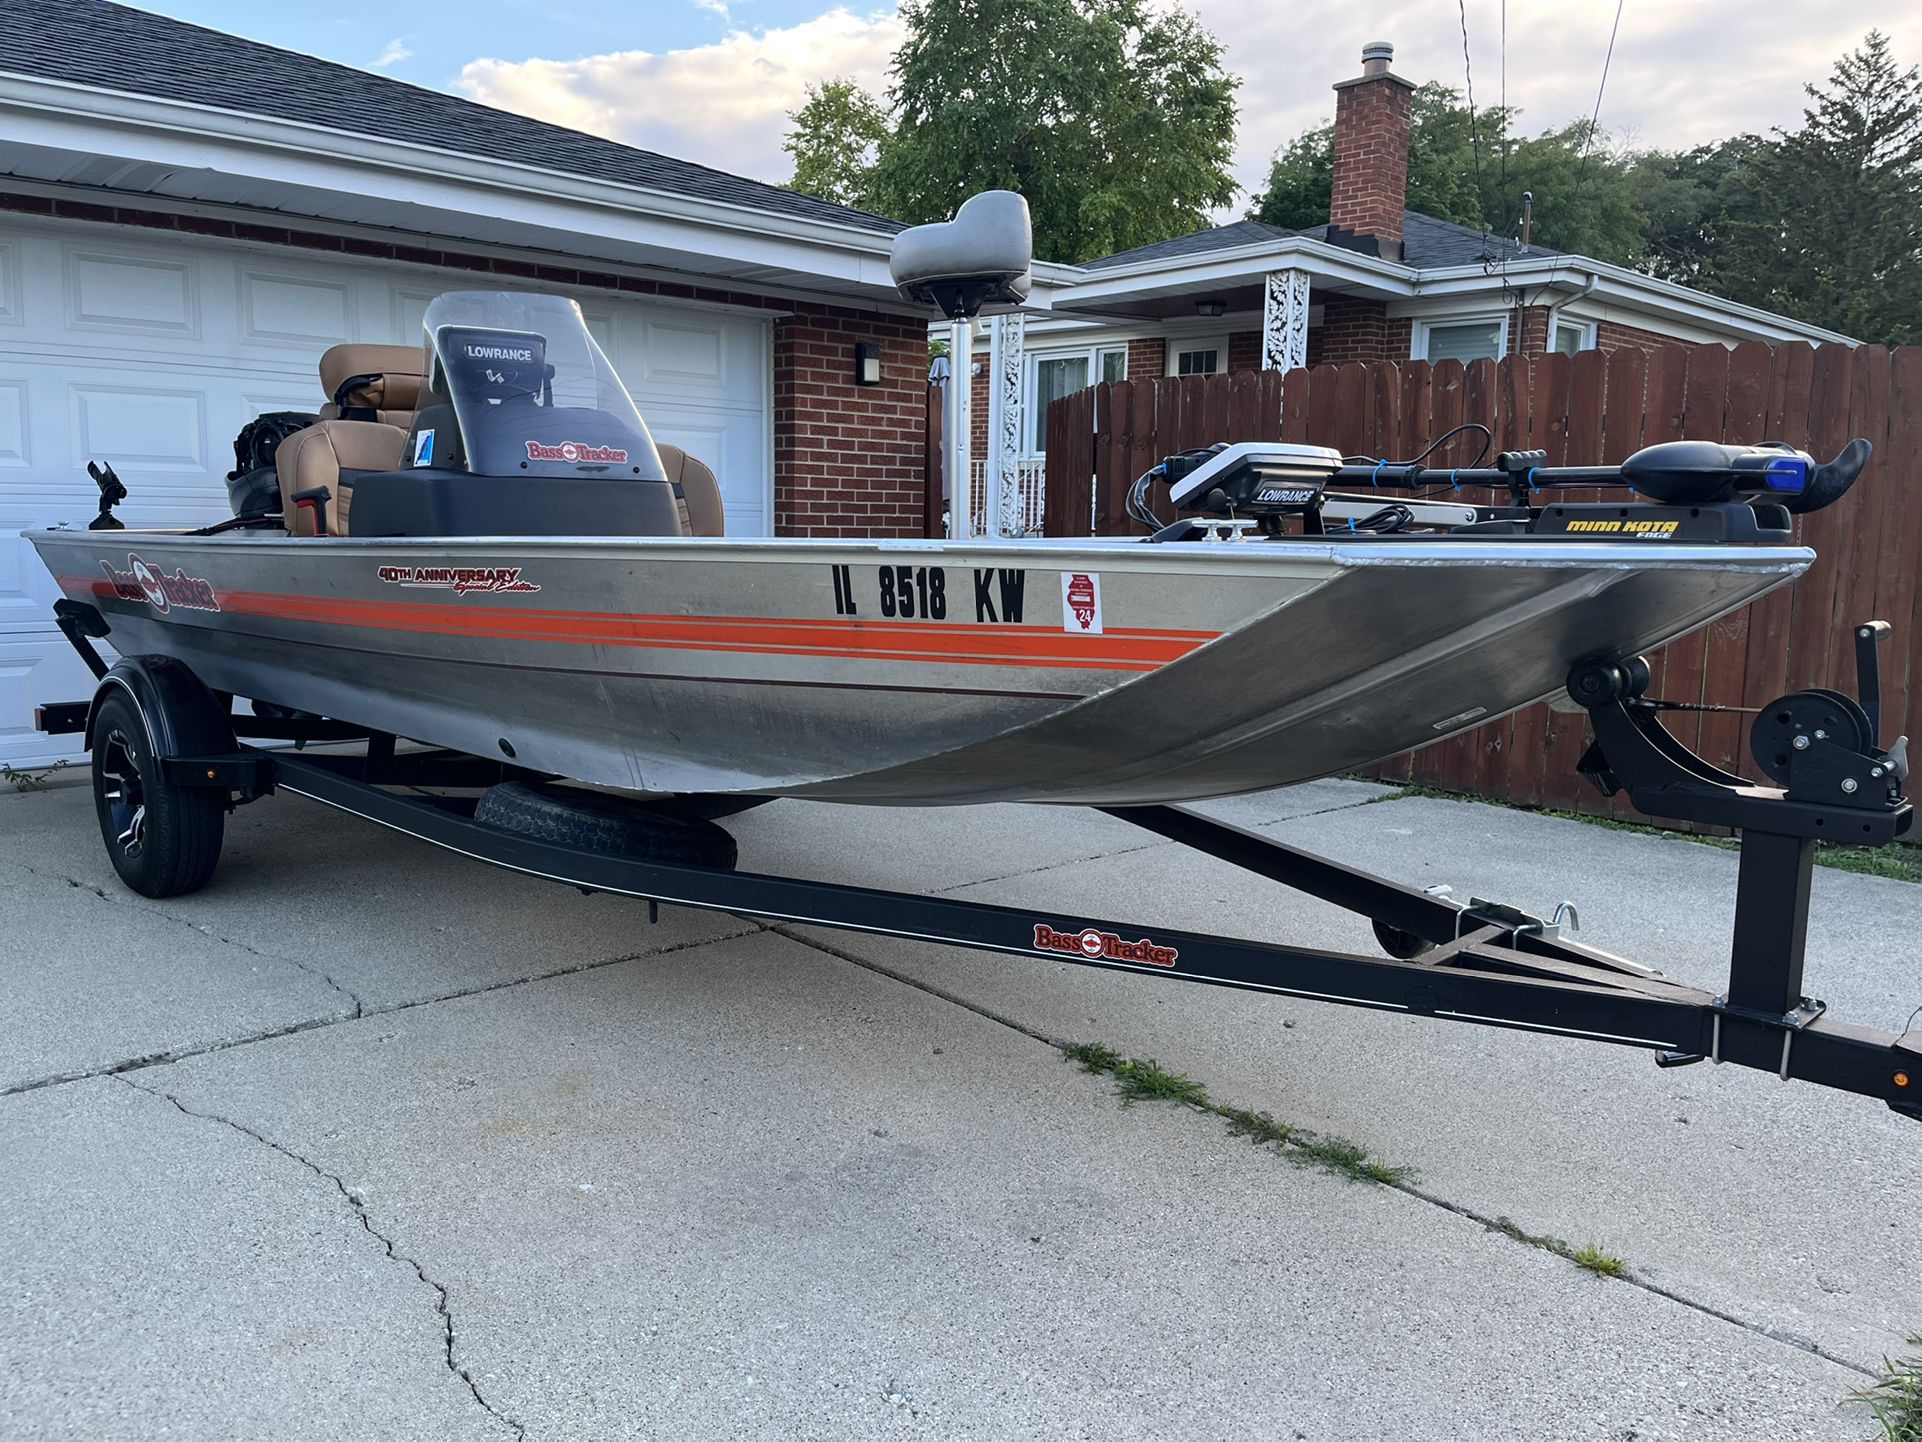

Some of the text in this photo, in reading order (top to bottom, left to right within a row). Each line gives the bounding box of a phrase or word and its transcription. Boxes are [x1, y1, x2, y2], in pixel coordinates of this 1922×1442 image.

[468, 345, 532, 361] LOWRANCE
[528, 442, 627, 463] Bass Tracker
[1257, 489, 1314, 502] LOWRANCE
[1622, 521, 1679, 532] KOTA
[379, 566, 518, 583] 40TH ANNIVERSARY
[147, 564, 219, 611] Tracker
[453, 580, 540, 595] Special Edition
[832, 564, 1025, 624] IL 8518 KW
[1080, 609, 1091, 622] 24
[1036, 927, 1177, 965] Bass Tracker
